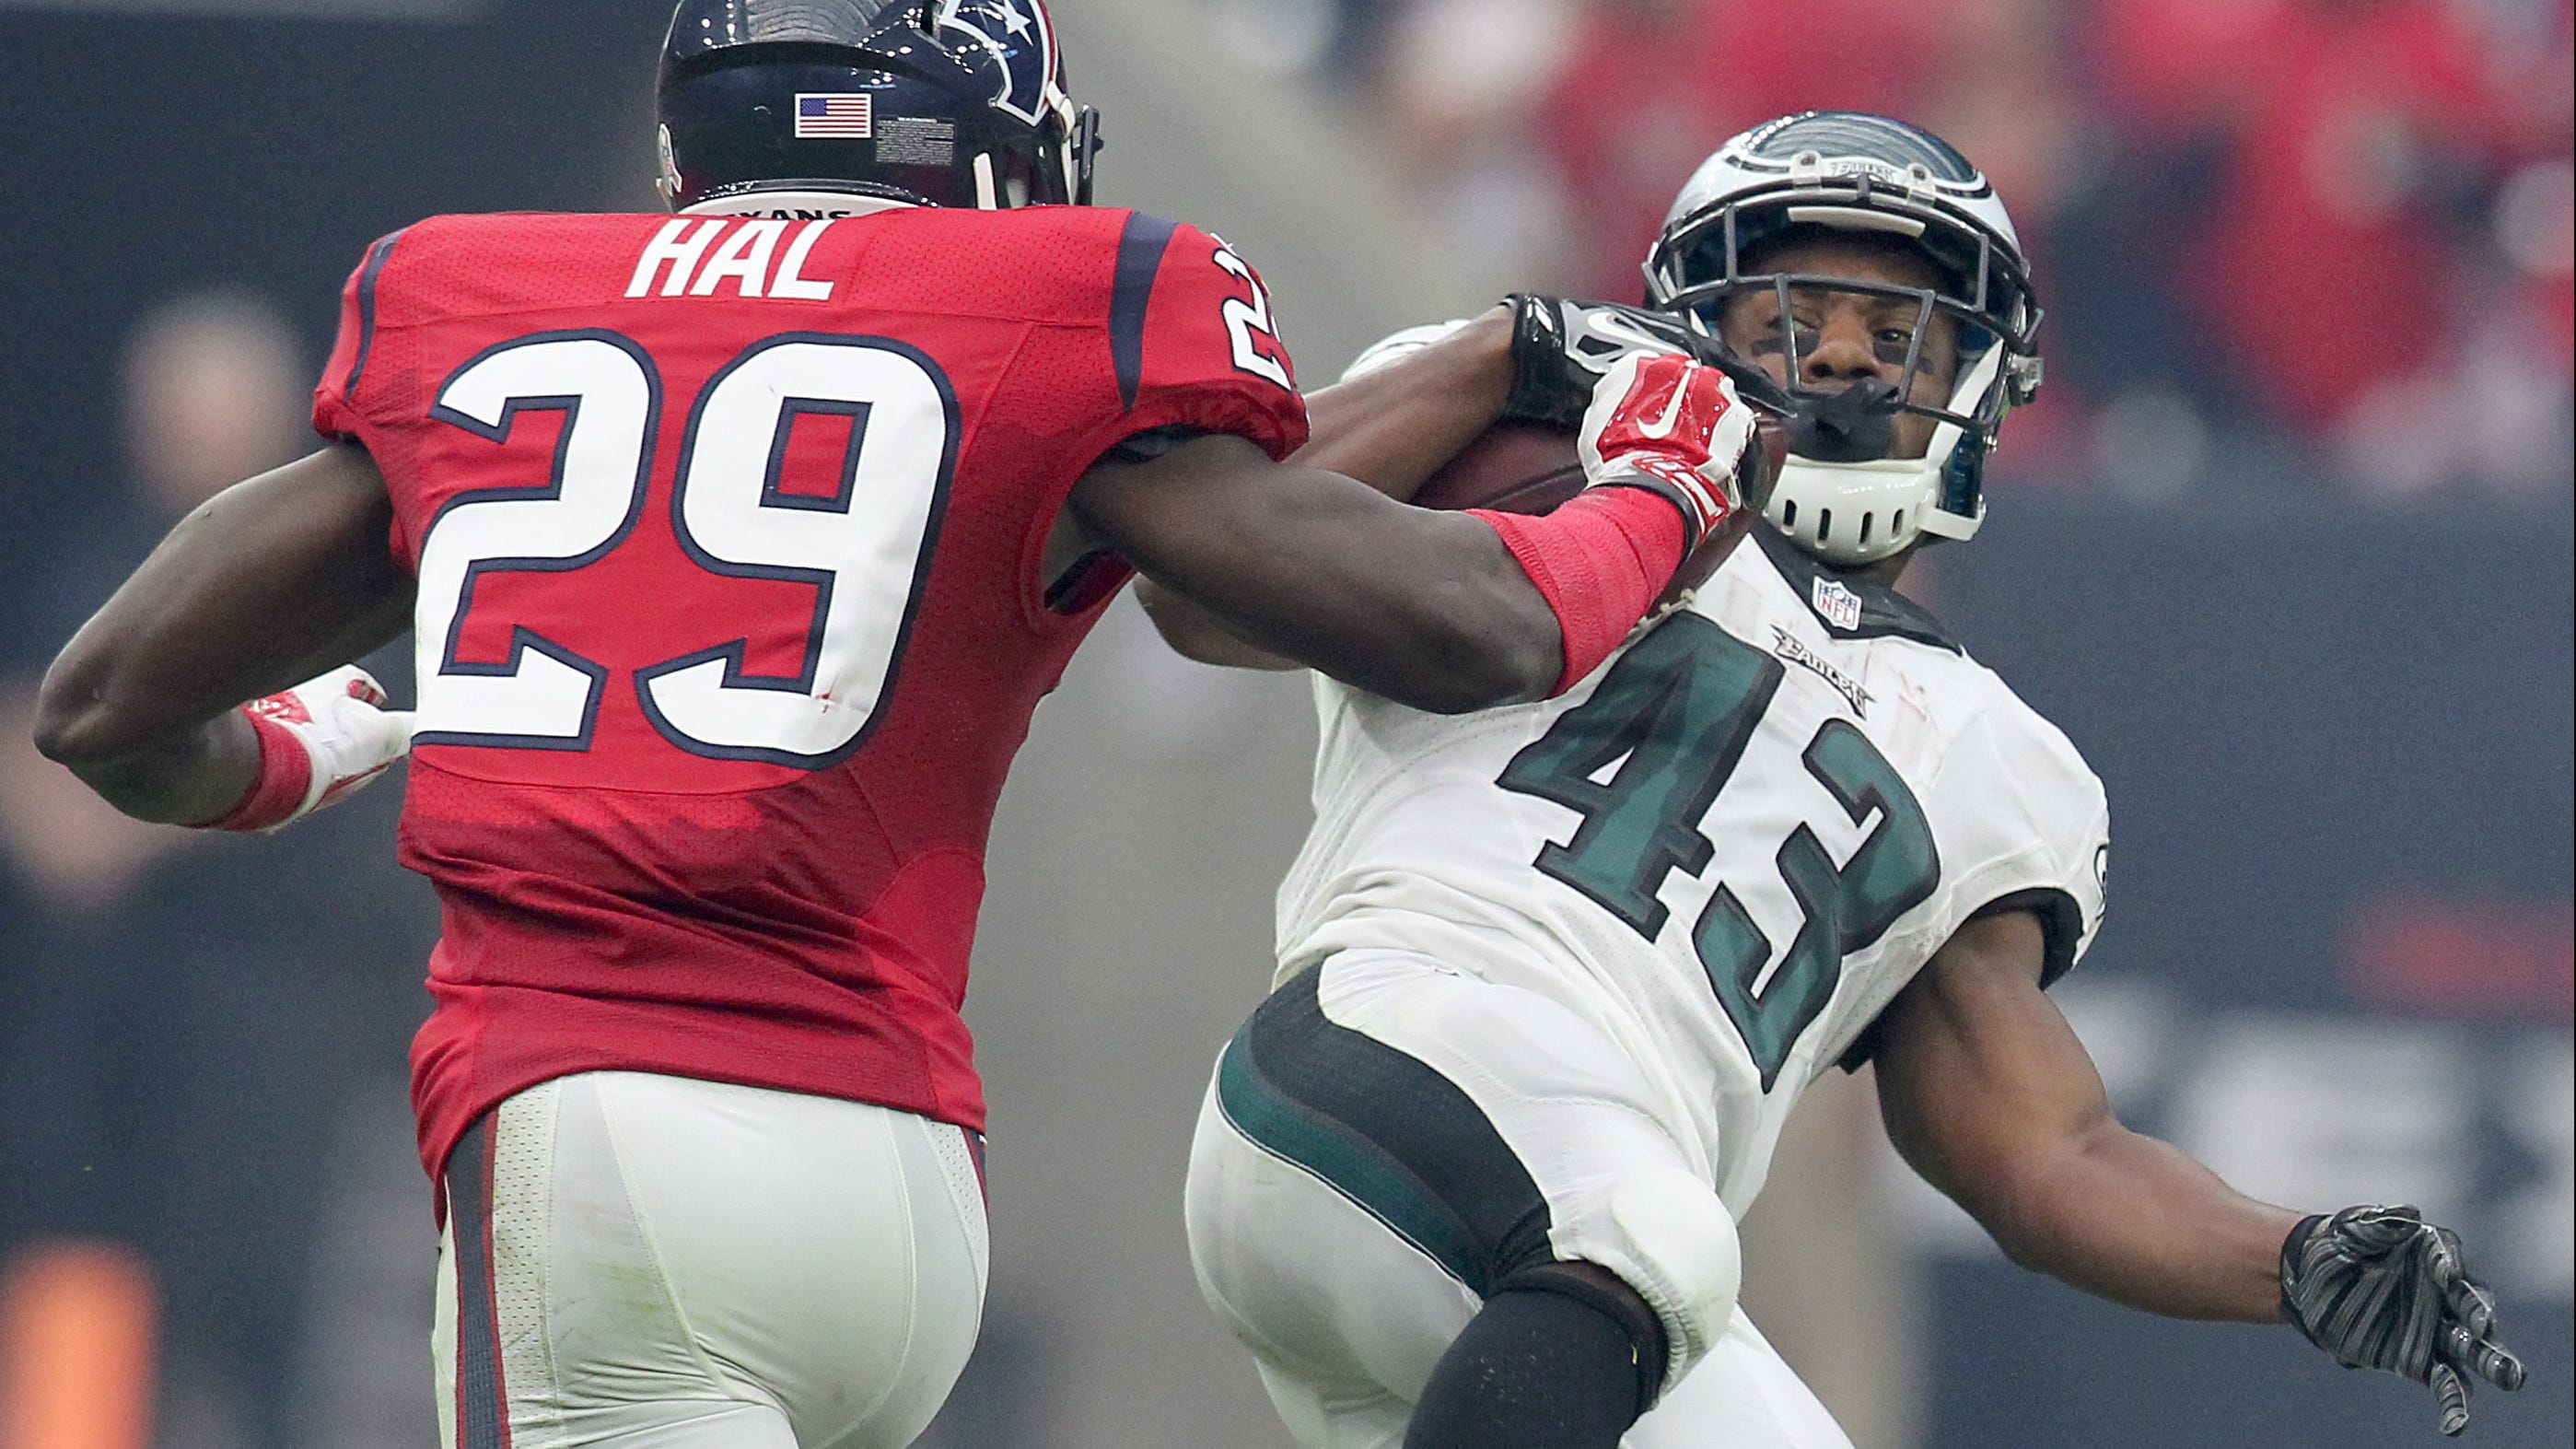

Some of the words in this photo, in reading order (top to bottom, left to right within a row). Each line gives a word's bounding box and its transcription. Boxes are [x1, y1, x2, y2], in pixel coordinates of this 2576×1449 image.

[624, 218, 836, 300] HAL
[1210, 246, 1295, 395] 2
[411, 327, 962, 771] 29
[1819, 596, 1852, 624] NFL
[1494, 608, 1941, 1094] 43
